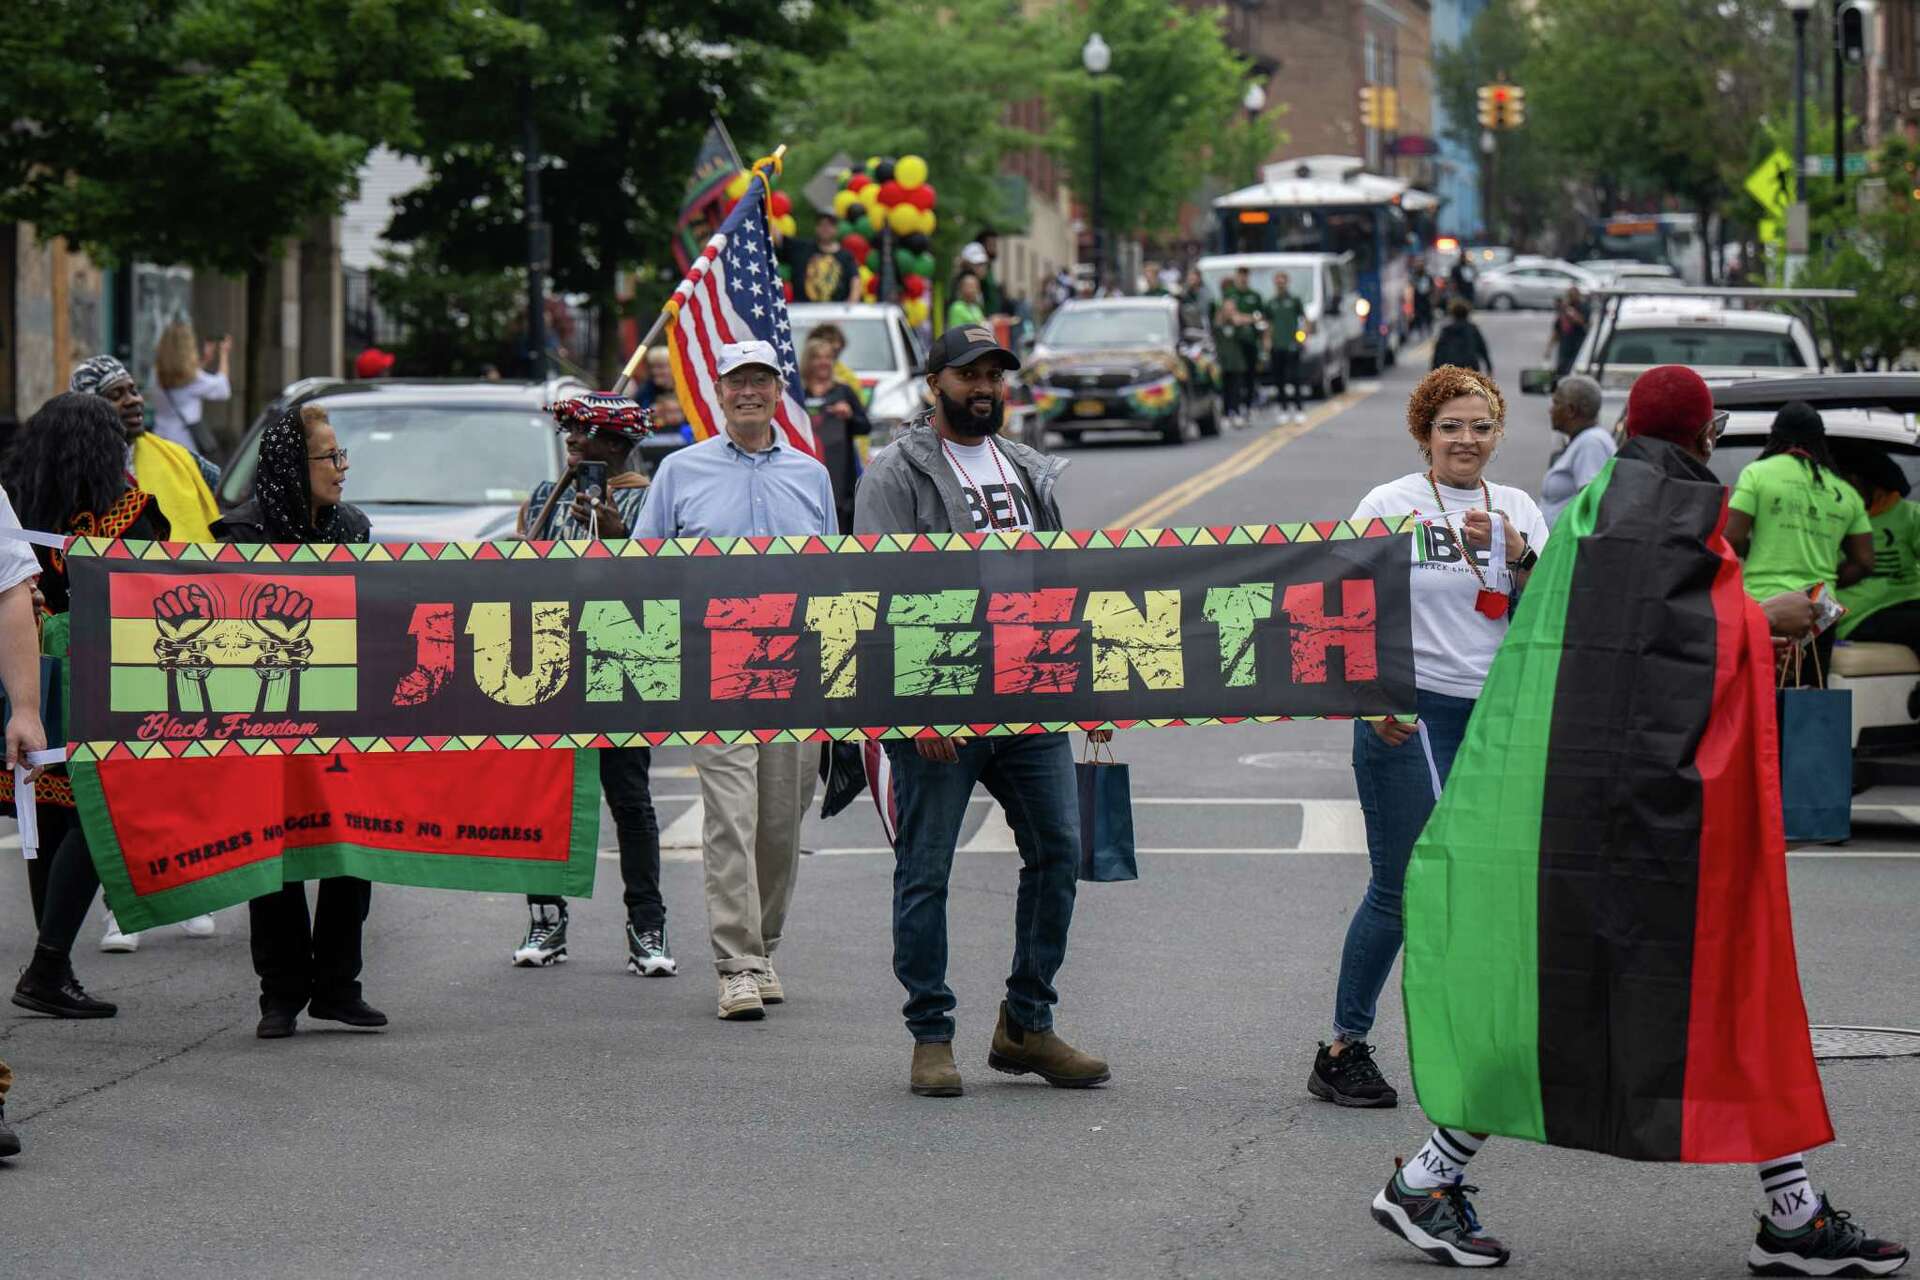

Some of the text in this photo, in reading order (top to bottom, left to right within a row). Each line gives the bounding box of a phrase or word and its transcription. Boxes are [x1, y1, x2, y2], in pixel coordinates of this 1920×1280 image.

[392, 579, 1378, 706] JUNETEENTH
[137, 713, 319, 740] Black Freedom
[148, 857, 169, 876] IF
[415, 822, 441, 838] NO
[455, 824, 543, 842] PROGRESS
